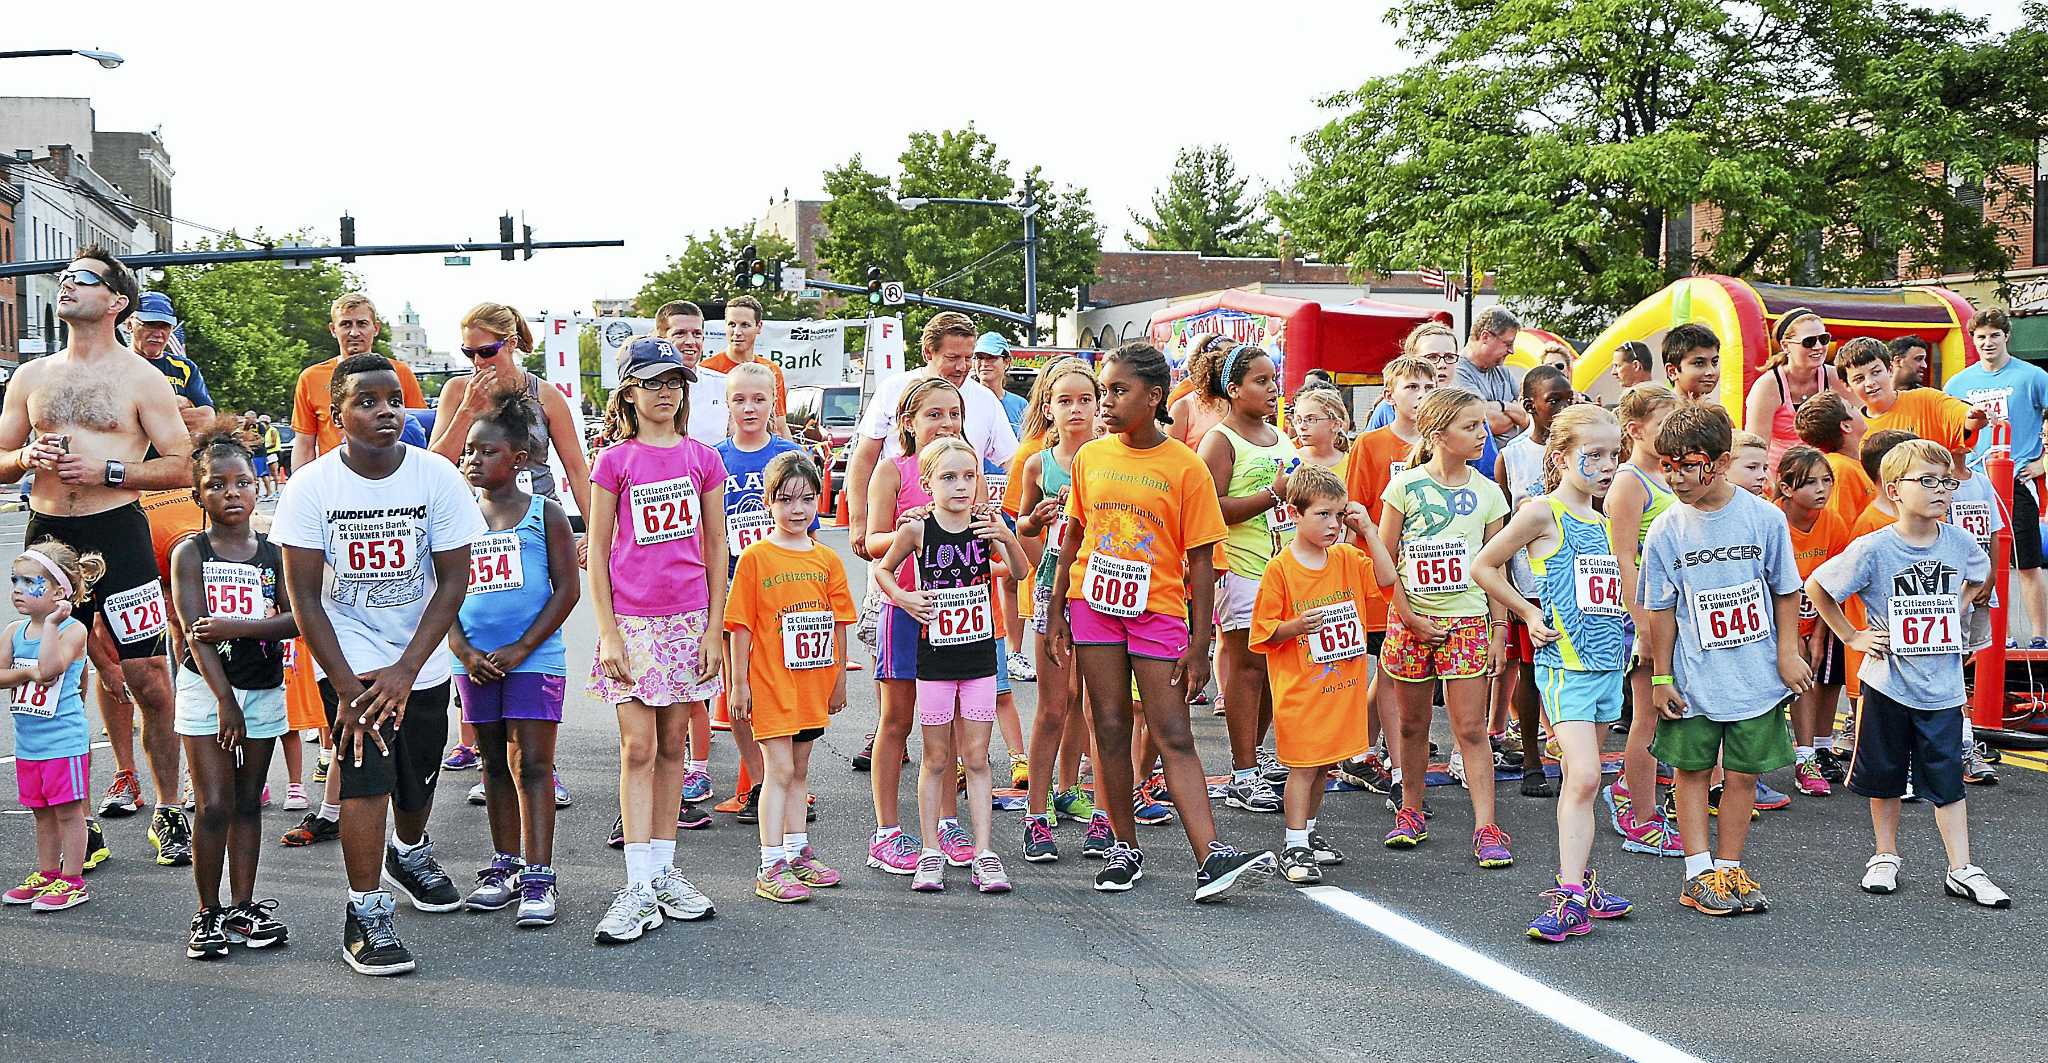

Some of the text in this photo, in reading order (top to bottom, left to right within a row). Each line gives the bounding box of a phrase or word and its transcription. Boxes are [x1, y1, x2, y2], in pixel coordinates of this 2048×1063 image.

[1232, 320, 1264, 343] JUMP
[771, 348, 823, 370] Bank
[640, 480, 691, 497] Citizens Bank
[643, 494, 670, 505] SUMMER
[672, 492, 682, 500] FUN
[348, 520, 407, 532] Citizens Bank
[643, 498, 693, 534] 624
[350, 532, 380, 540] SUMMER
[492, 536, 512, 546] Bank
[739, 526, 776, 550] 61
[1445, 541, 1462, 550] Bank
[348, 538, 406, 571] 653
[925, 539, 986, 569] LOVE
[1098, 557, 1145, 573] Citizens Bank
[1684, 545, 1762, 568] SOCCER
[206, 566, 237, 575] Citizens
[1098, 566, 1120, 578] SUMMER
[1121, 572, 1134, 580] FUN
[1416, 558, 1462, 585] 656
[207, 584, 252, 615] 655
[938, 588, 985, 600] Citizens Bank
[1092, 574, 1138, 608] 608
[1708, 584, 1756, 602] Citizens Bank
[1710, 599, 1738, 610] SUMMER
[1902, 600, 1936, 608] Citizens
[120, 600, 162, 634] 128
[796, 616, 822, 624] Citizens
[938, 605, 984, 636] 626
[1710, 602, 1760, 639] 646
[1320, 620, 1360, 652] 652
[1902, 616, 1952, 645] 671
[796, 632, 830, 660] 637
[1321, 684, 1336, 694] July
